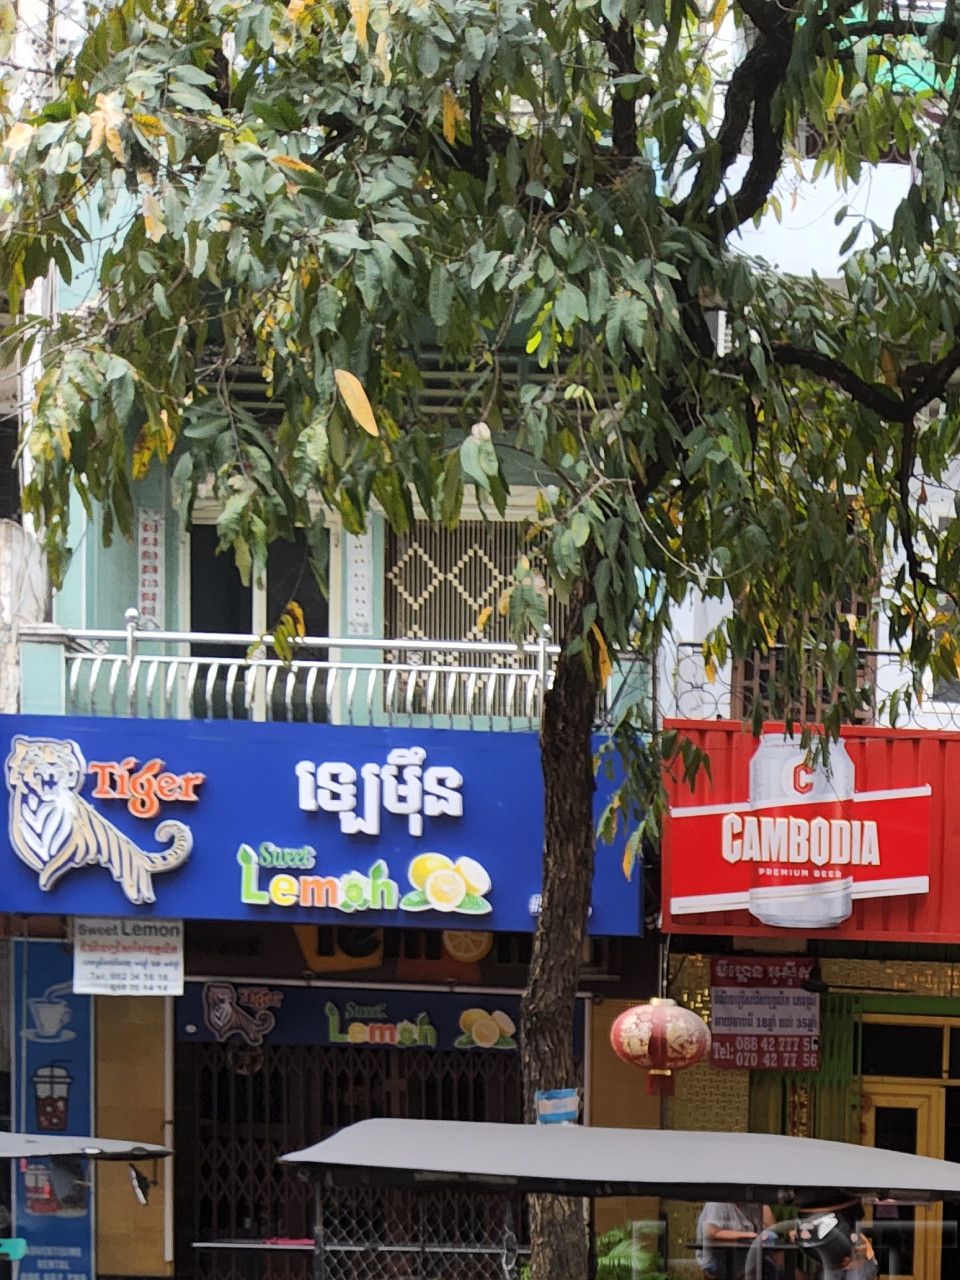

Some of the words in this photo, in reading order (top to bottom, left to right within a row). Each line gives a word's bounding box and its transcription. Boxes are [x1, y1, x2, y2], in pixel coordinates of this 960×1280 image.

[89, 757, 206, 819] Tiger
[721, 812, 881, 866] CAMBODIA
[257, 842, 316, 870] Sweet
[237, 844, 400, 912] Lemon
[758, 867, 809, 878] PREMIUM
[813, 868, 842, 879] BEER
[121, 919, 180, 937] Lemon
[713, 1042, 734, 1059] Tel:
[736, 1036, 758, 1051] 088
[760, 1037, 775, 1051] 42
[778, 1038, 800, 1051] 777
[736, 1053, 758, 1067] 070
[763, 1053, 778, 1067] 42
[783, 1054, 797, 1067] 77
[803, 1054, 818, 1067] 56
